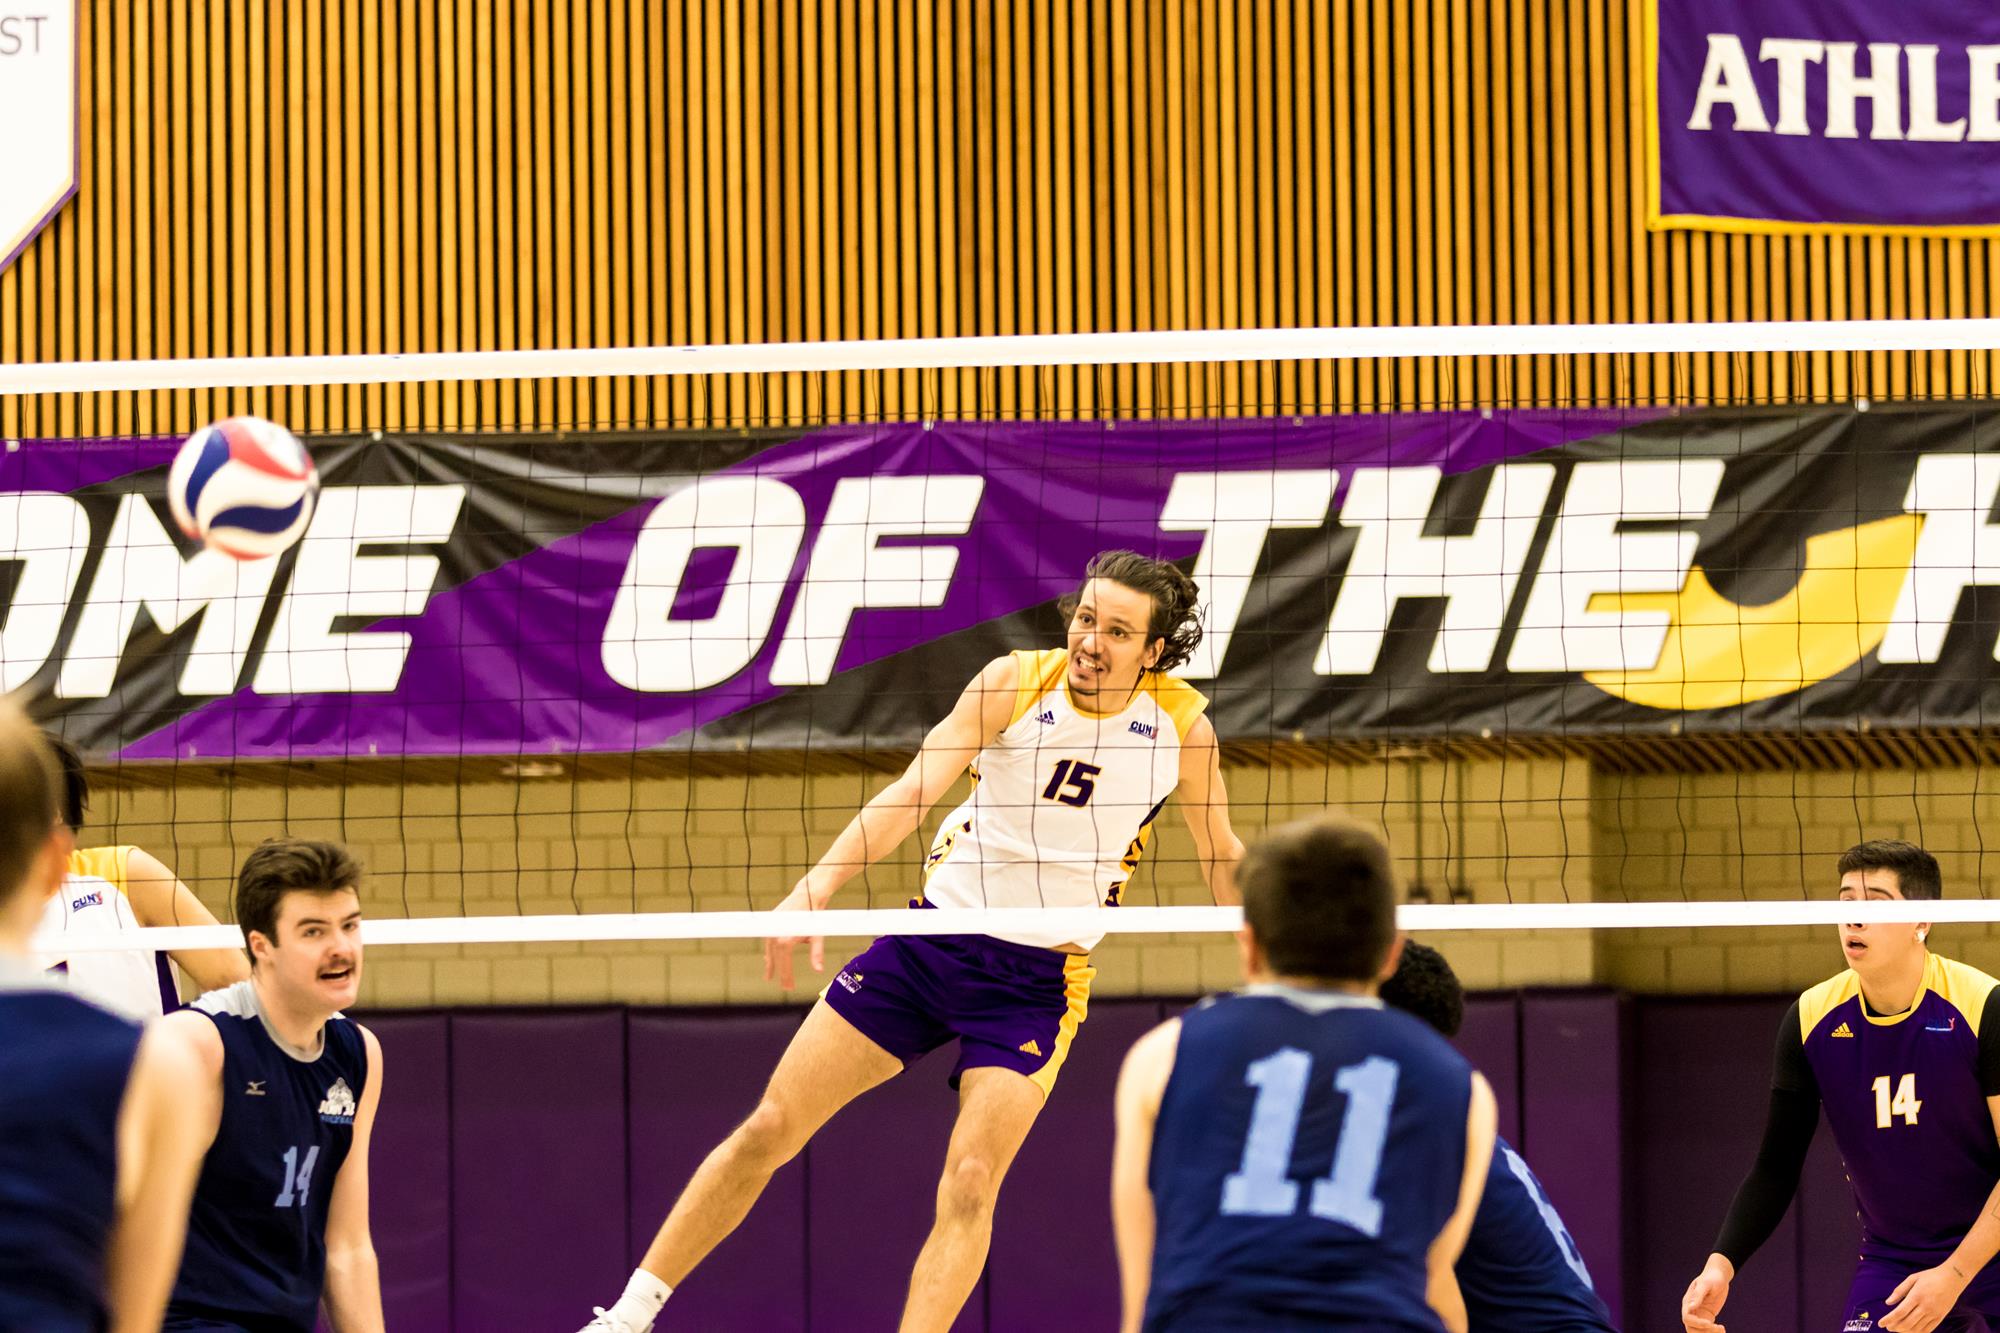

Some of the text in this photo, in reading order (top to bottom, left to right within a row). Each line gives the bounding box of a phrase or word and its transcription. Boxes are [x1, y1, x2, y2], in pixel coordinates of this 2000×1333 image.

[1686, 33, 2000, 142] ATHLE
[601, 475, 985, 693] OF
[1159, 460, 1726, 679] THE
[1042, 759, 1102, 808] 15
[1220, 1046, 1400, 1239] 11
[1871, 1073, 1922, 1129] 14
[274, 1145, 320, 1207] 14
